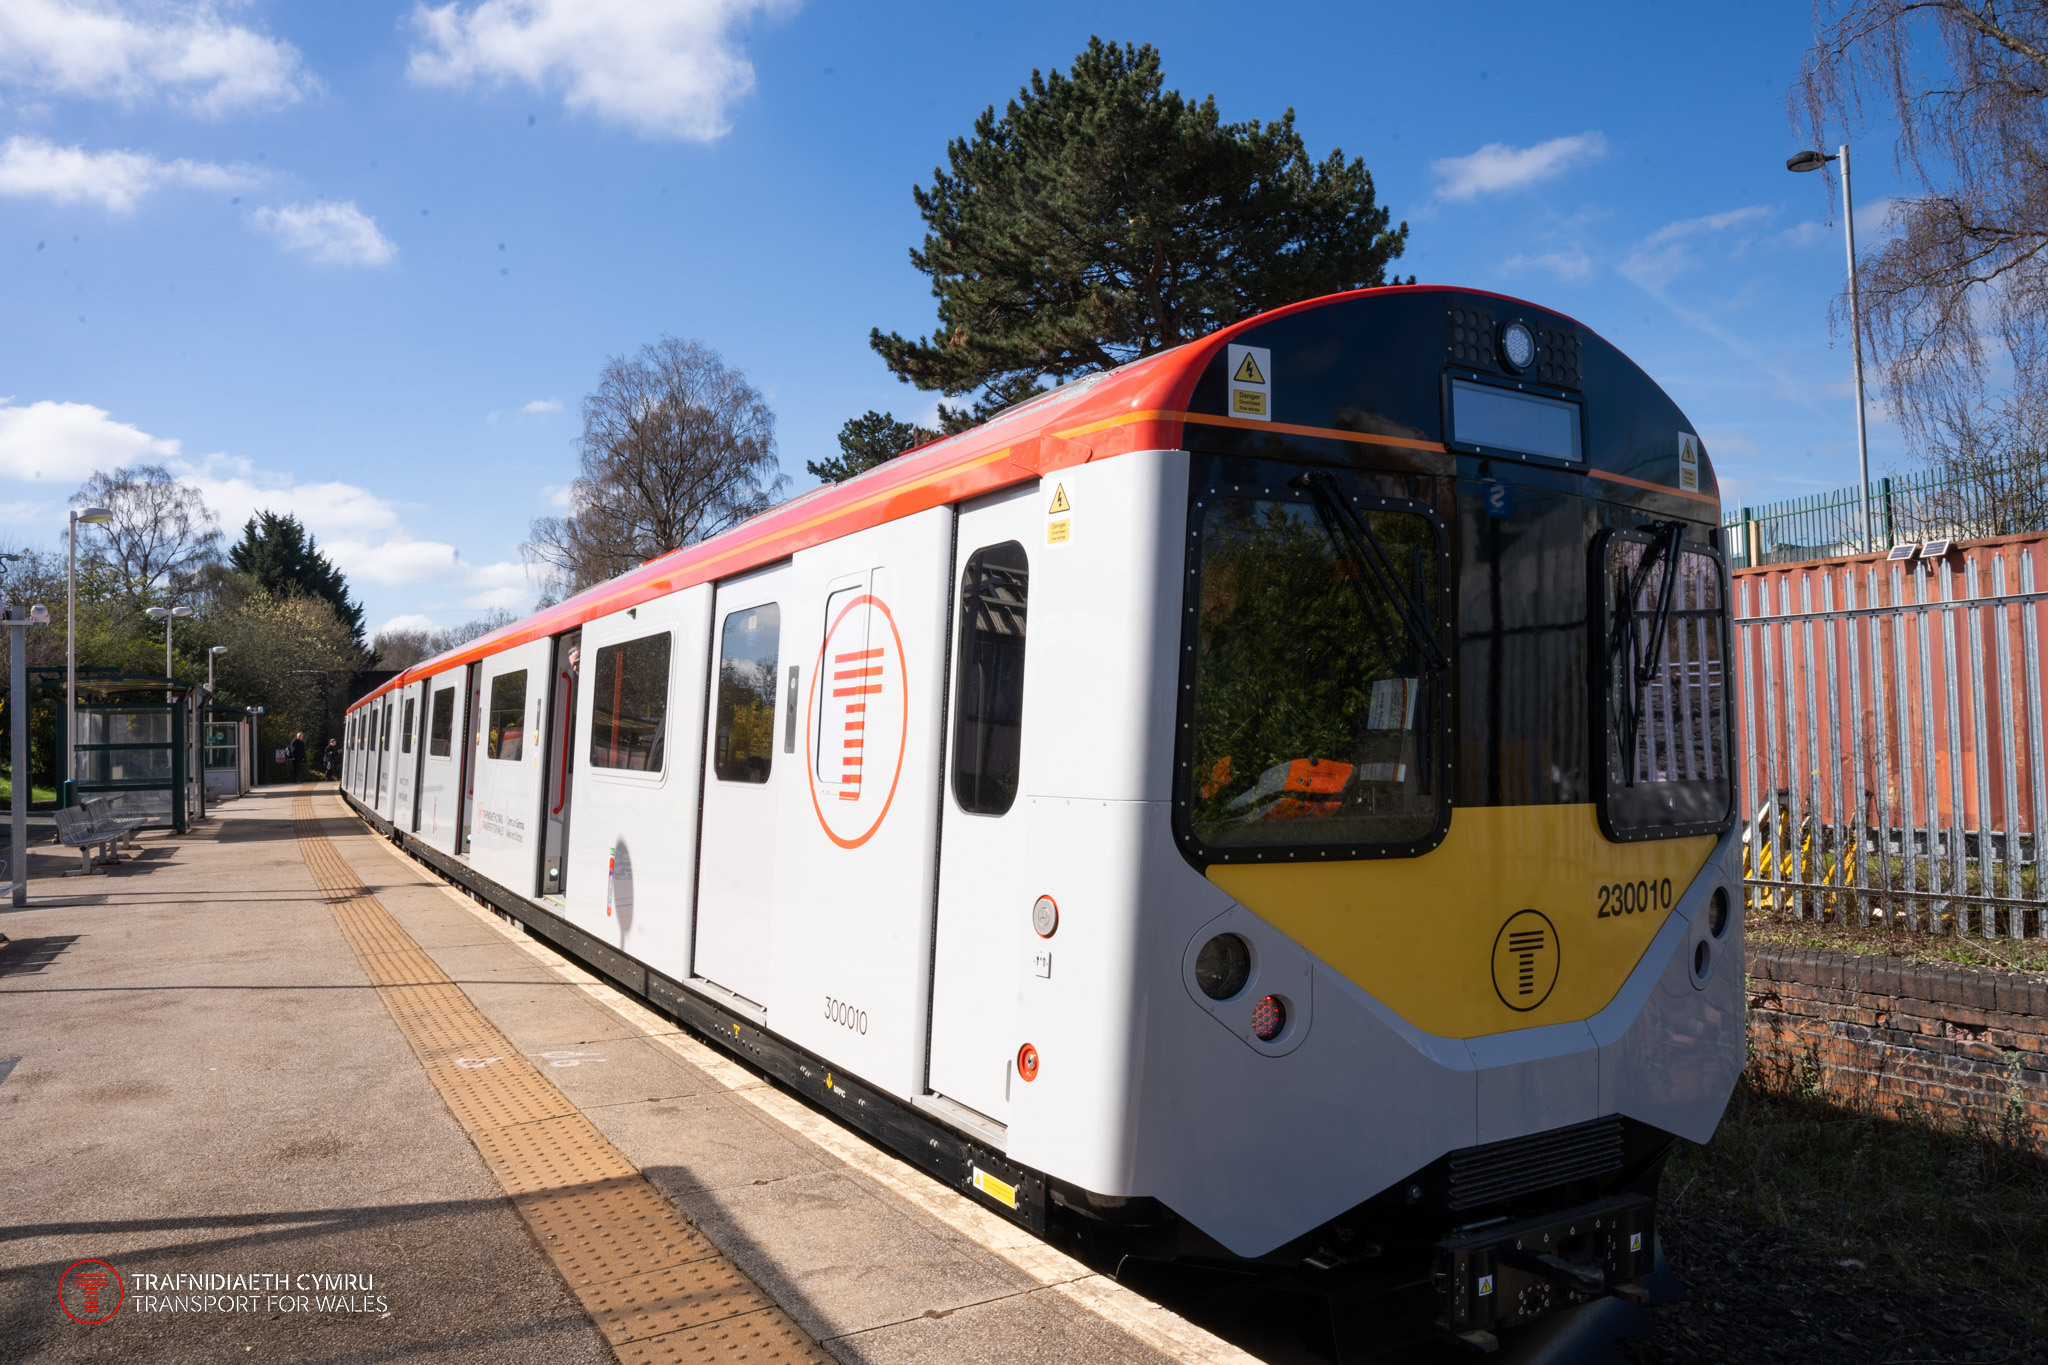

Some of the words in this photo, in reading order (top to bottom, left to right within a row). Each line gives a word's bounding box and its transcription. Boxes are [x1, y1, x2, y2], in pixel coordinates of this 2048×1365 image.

[1239, 392, 1261, 400] Danger
[1597, 877, 1672, 919] 230010
[824, 996, 868, 1035] 300010
